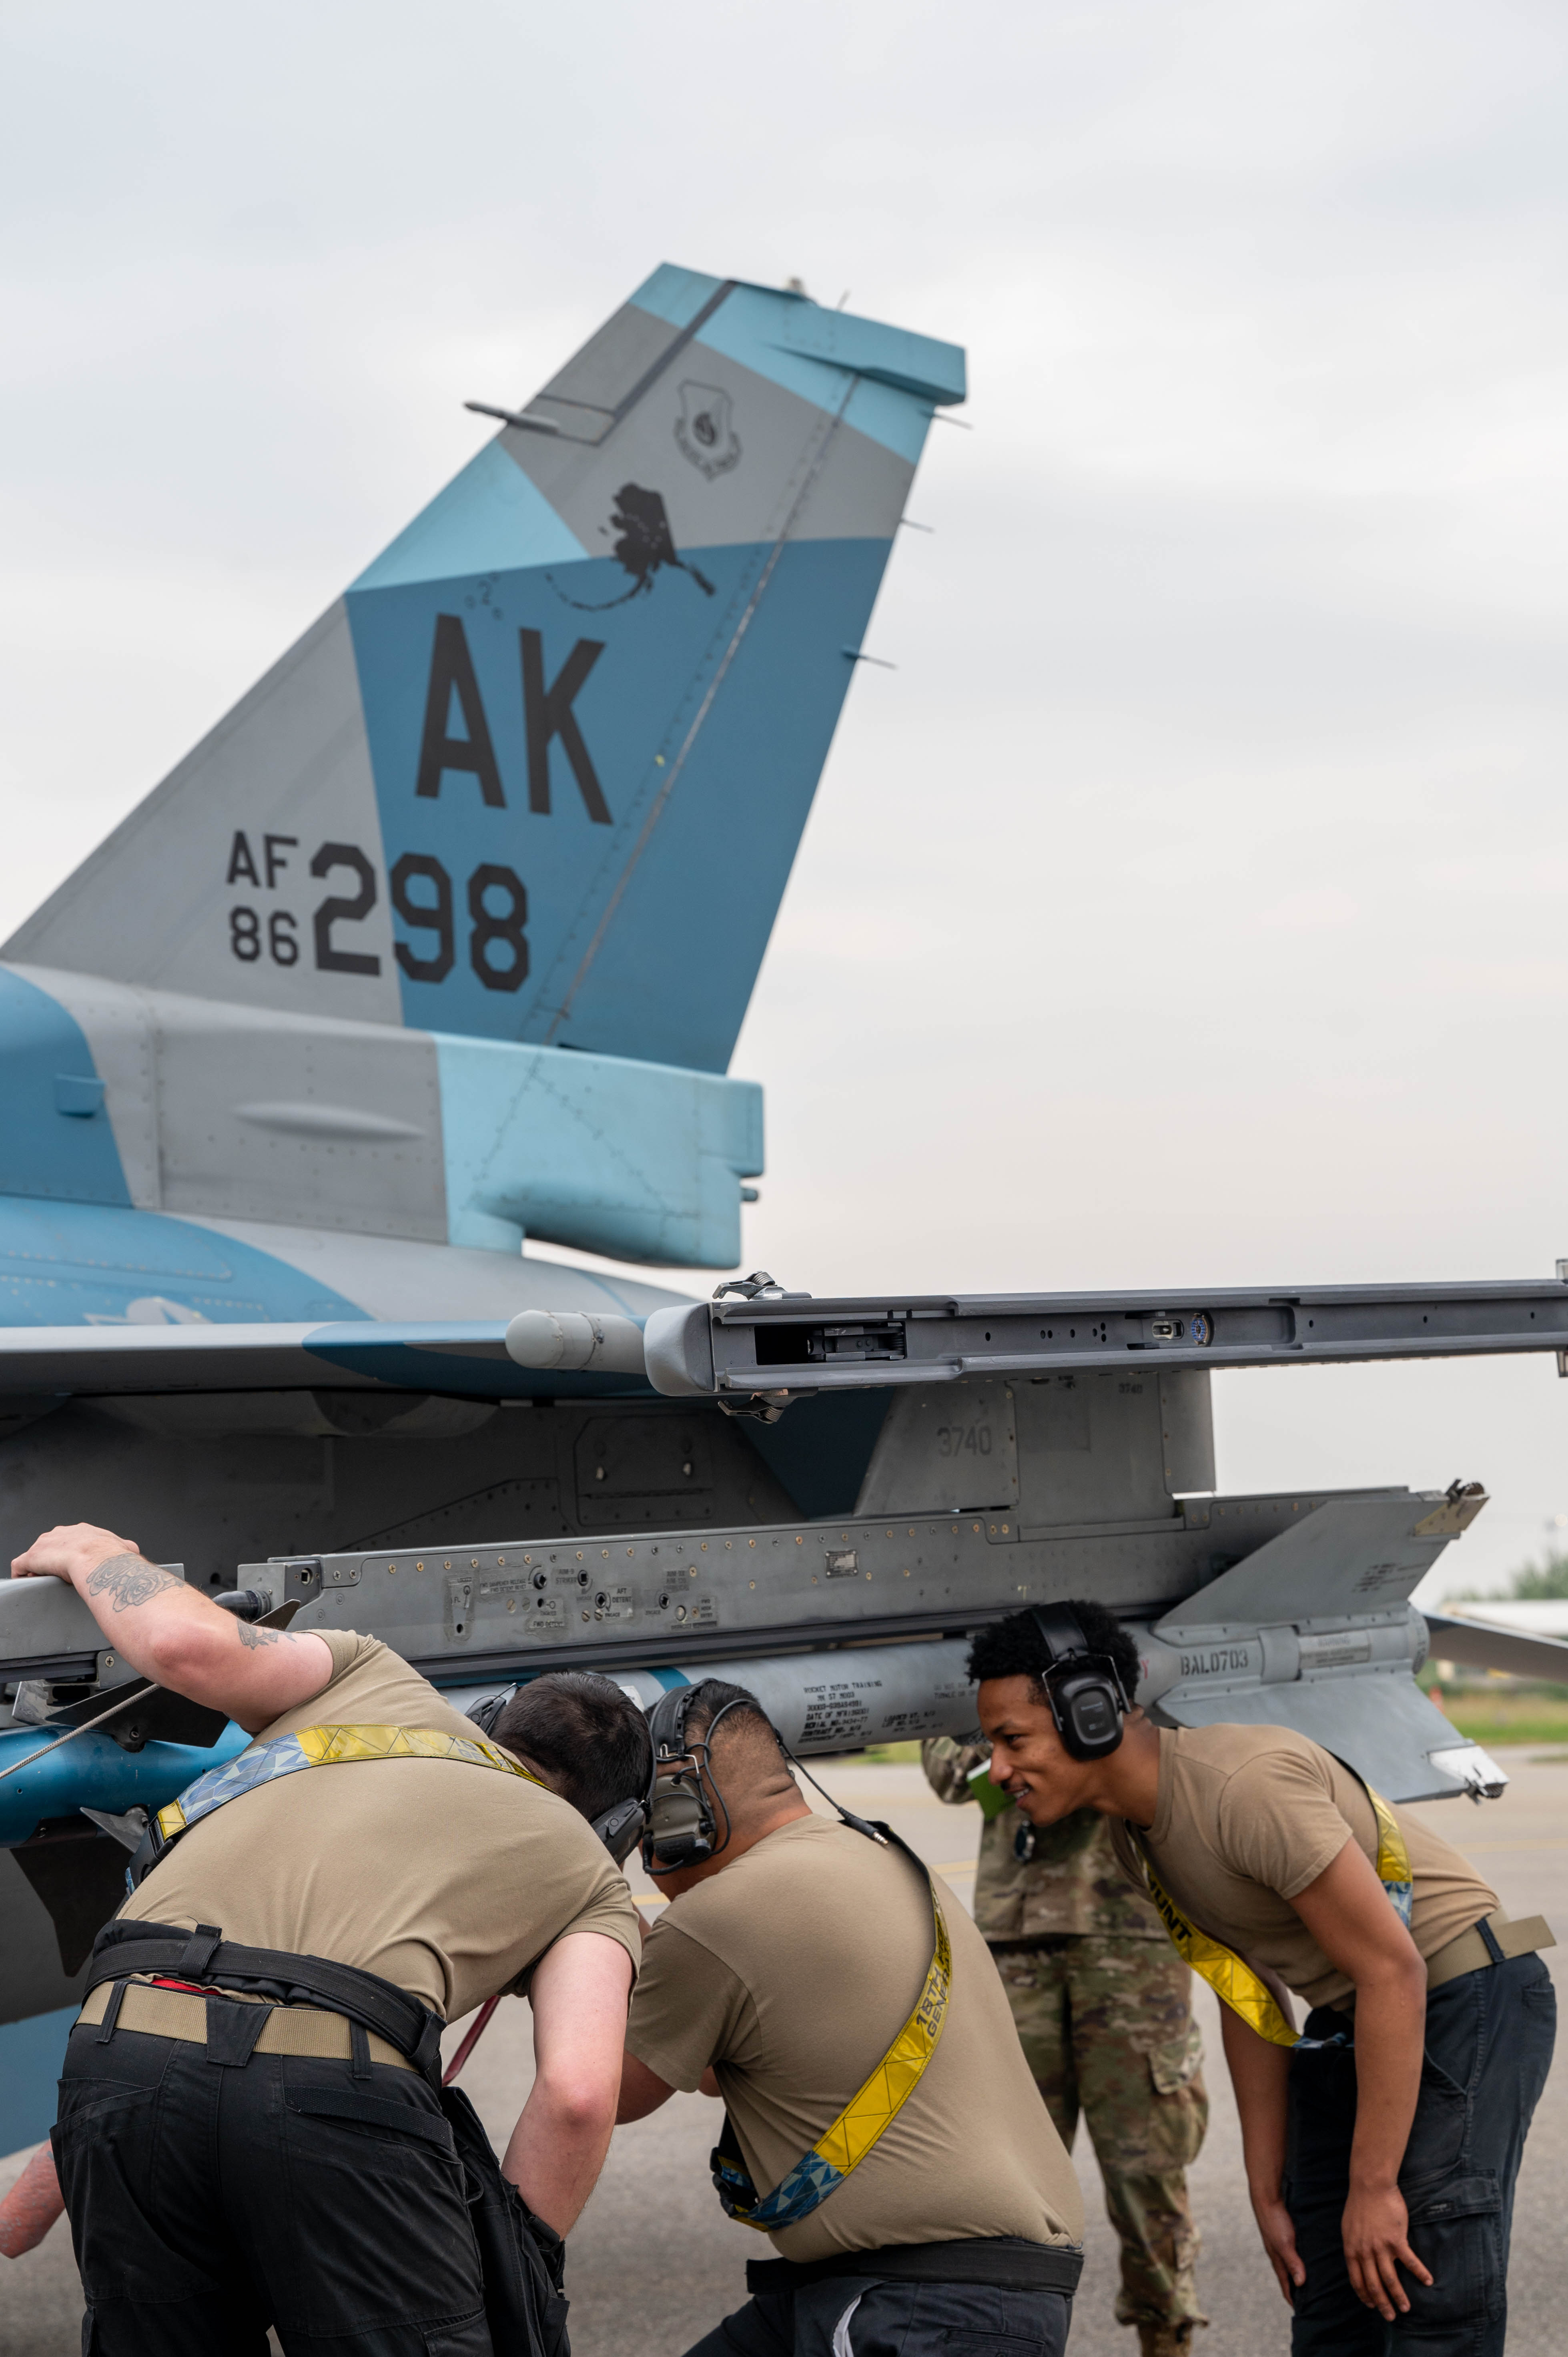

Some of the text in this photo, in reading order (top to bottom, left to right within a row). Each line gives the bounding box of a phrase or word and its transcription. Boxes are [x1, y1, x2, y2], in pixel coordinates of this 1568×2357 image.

[415, 613, 614, 826] AK
[227, 830, 299, 889] AF
[229, 905, 299, 967] 86
[310, 842, 529, 993] 298
[938, 1426, 992, 1457] 3740
[803, 1680, 882, 1694] ROCKET MOTOR TRAINING
[806, 1711, 822, 1721] DATE
[916, 1966, 941, 2026] 18TH
